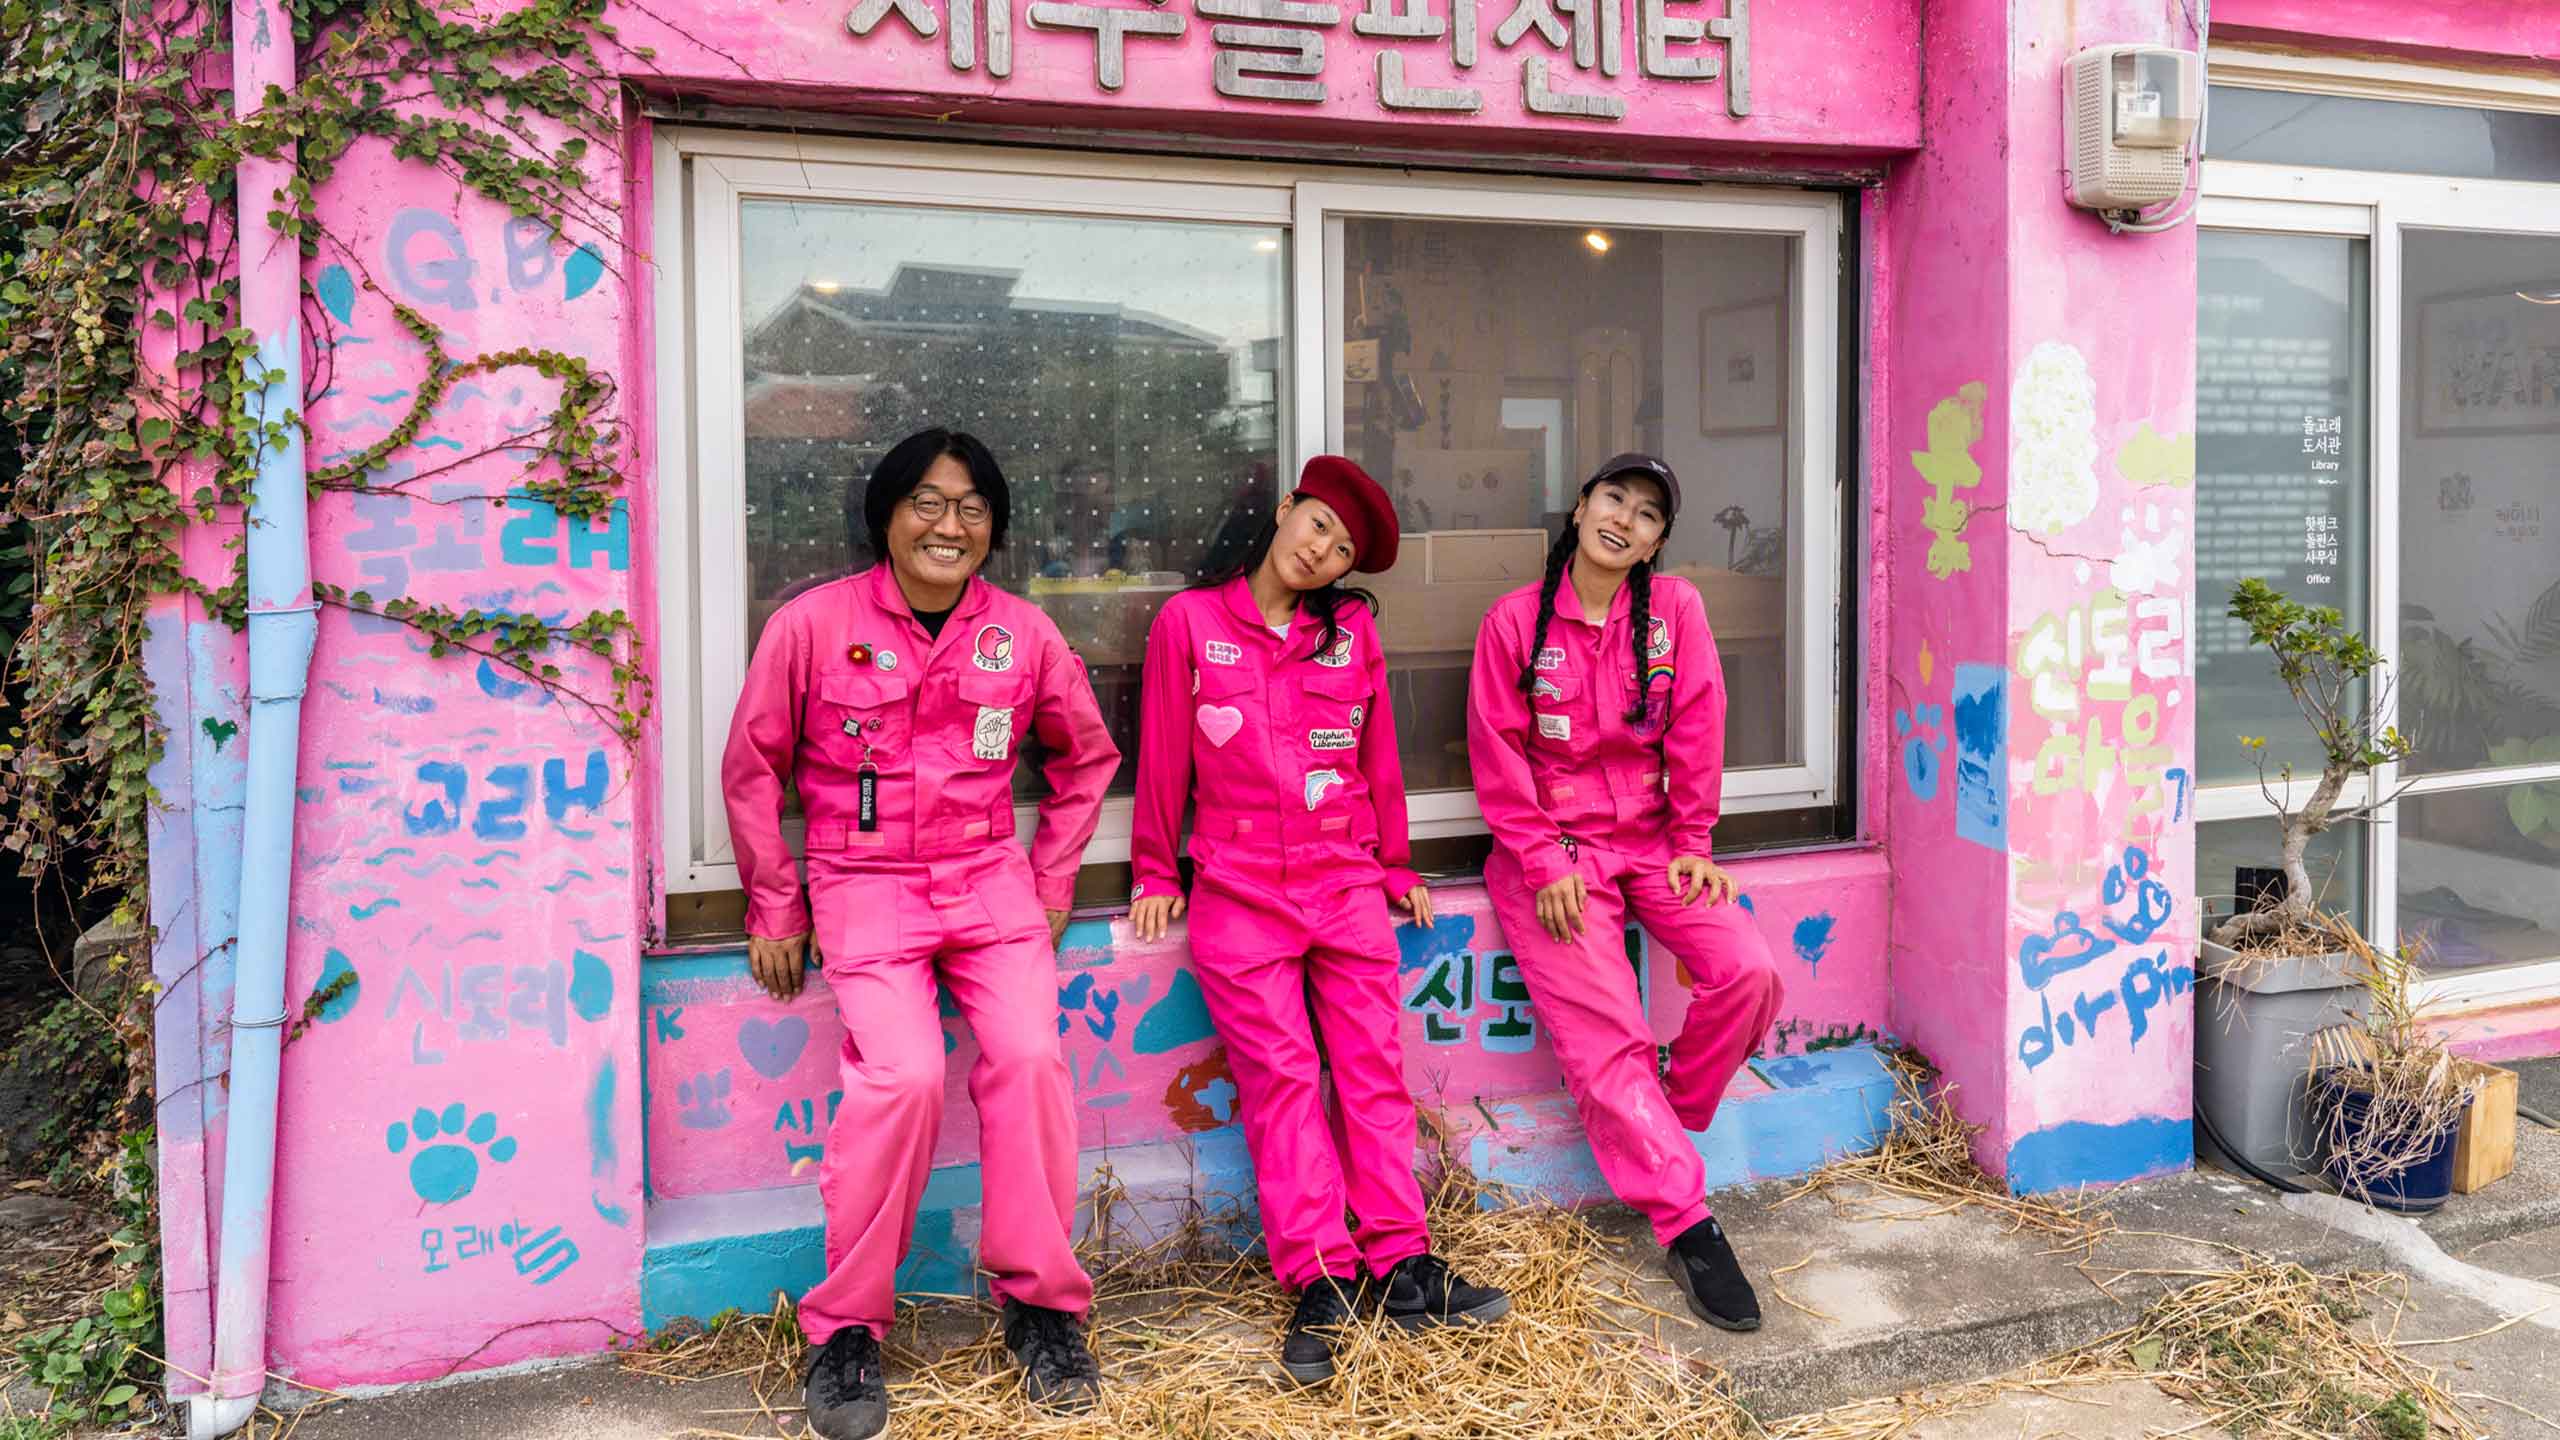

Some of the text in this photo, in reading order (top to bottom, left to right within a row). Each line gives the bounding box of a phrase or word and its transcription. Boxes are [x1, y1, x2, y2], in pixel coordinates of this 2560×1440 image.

[2302, 415, 2341, 435] 돌고래
[2301, 435, 2342, 455] 도서관
[2311, 459, 2339, 471] Library
[2305, 515, 2338, 532] 핫핑크
[2305, 549, 2337, 566] 사무실
[2306, 573, 2331, 585] Office
[2018, 595, 2194, 718] 신도리
[1311, 730, 1345, 741] Dolphin
[383, 959, 568, 1064] 신도리
